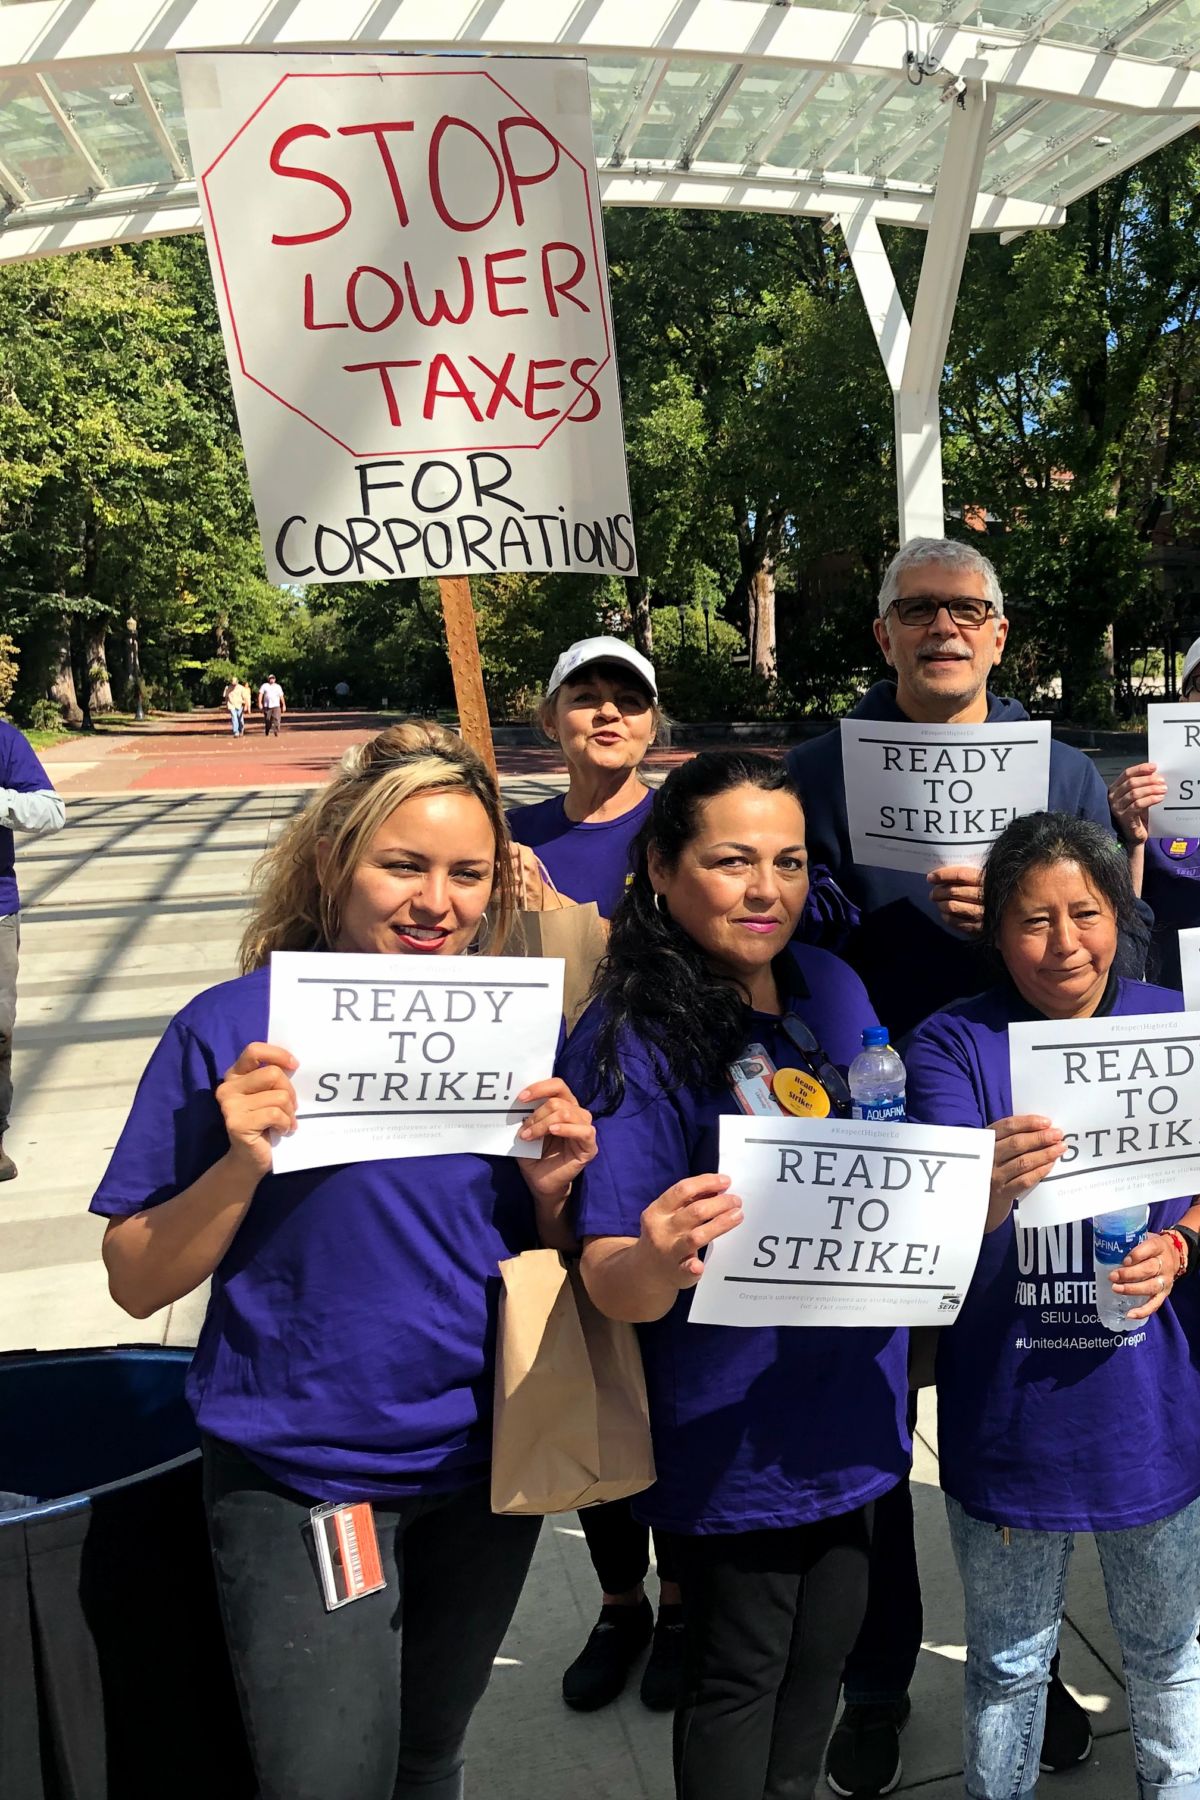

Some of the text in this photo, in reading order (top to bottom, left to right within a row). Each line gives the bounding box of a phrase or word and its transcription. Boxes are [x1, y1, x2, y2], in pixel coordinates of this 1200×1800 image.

[269, 115, 559, 245] STOP
[304, 241, 591, 332] LOWER
[343, 353, 602, 426] TAXES
[355, 452, 524, 515] FOR
[882, 746, 1014, 773] READY
[923, 779, 973, 804] TO
[332, 988, 513, 1022] READY
[388, 1031, 455, 1064] TO
[315, 1072, 513, 1102] STRIKE!
[1116, 1085, 1178, 1119] TO
[867, 1104, 904, 1121] AQUAFINA
[777, 1148, 947, 1193] READY
[827, 1196, 889, 1232] TO
[753, 1236, 941, 1276] STRIKE!
[1040, 1282, 1051, 1305] A
[1054, 1281, 1097, 1305] BETTE
[1041, 1311, 1101, 1324] SEIU Loca
[1015, 1331, 1146, 1349] #United4ABetterOregon
